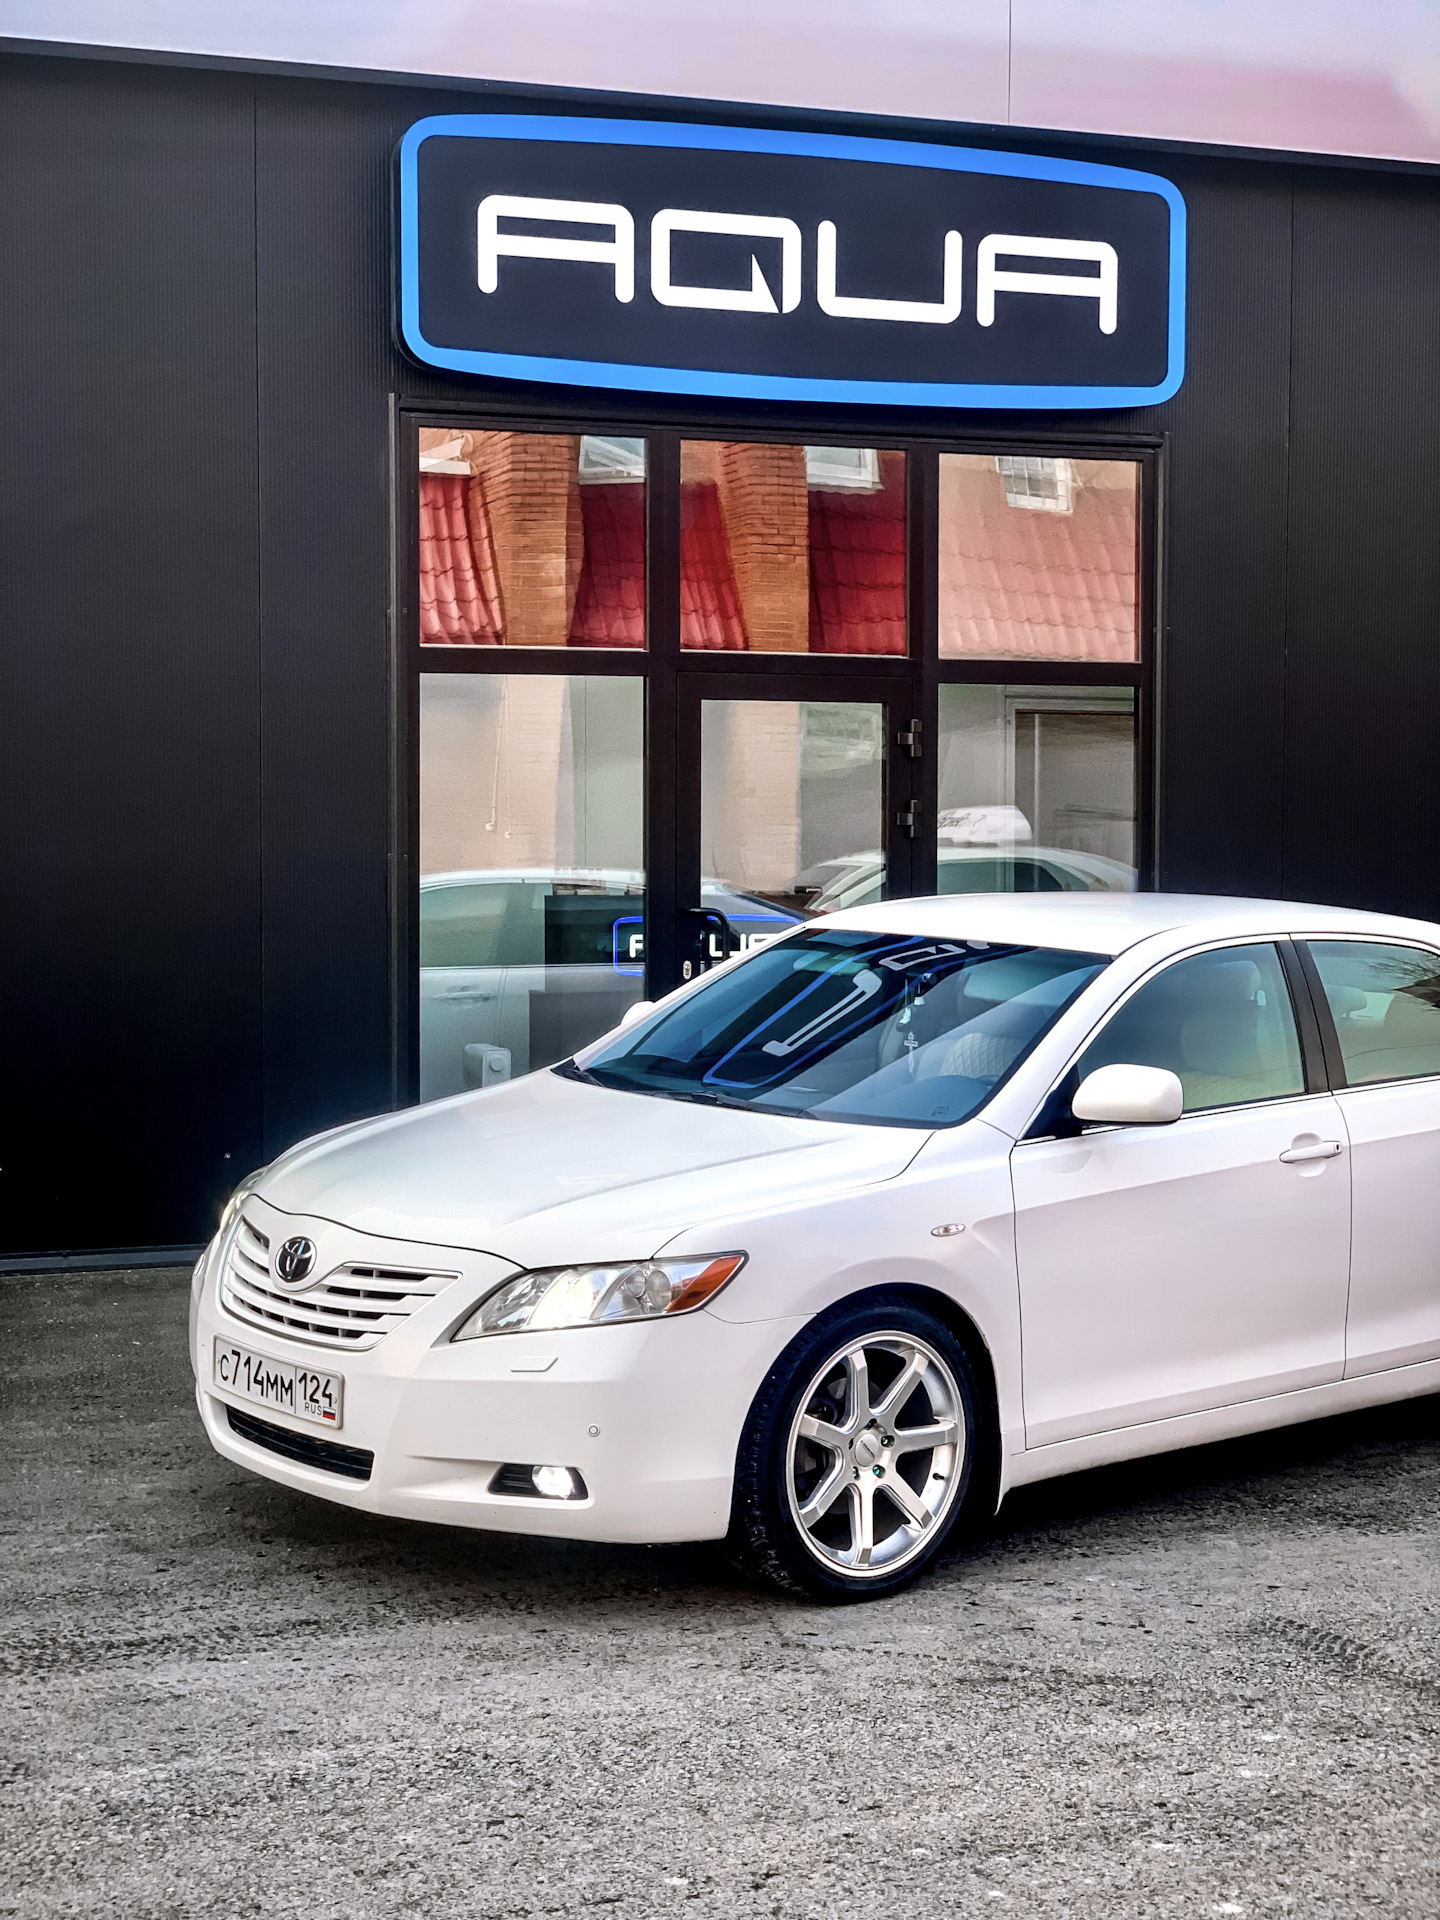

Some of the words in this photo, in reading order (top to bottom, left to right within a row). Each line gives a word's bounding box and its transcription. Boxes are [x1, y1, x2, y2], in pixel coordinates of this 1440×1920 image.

[477, 194, 1119, 335] AQUA
[298, 1372, 333, 1408] 124
[304, 1402, 322, 1416] RUS
